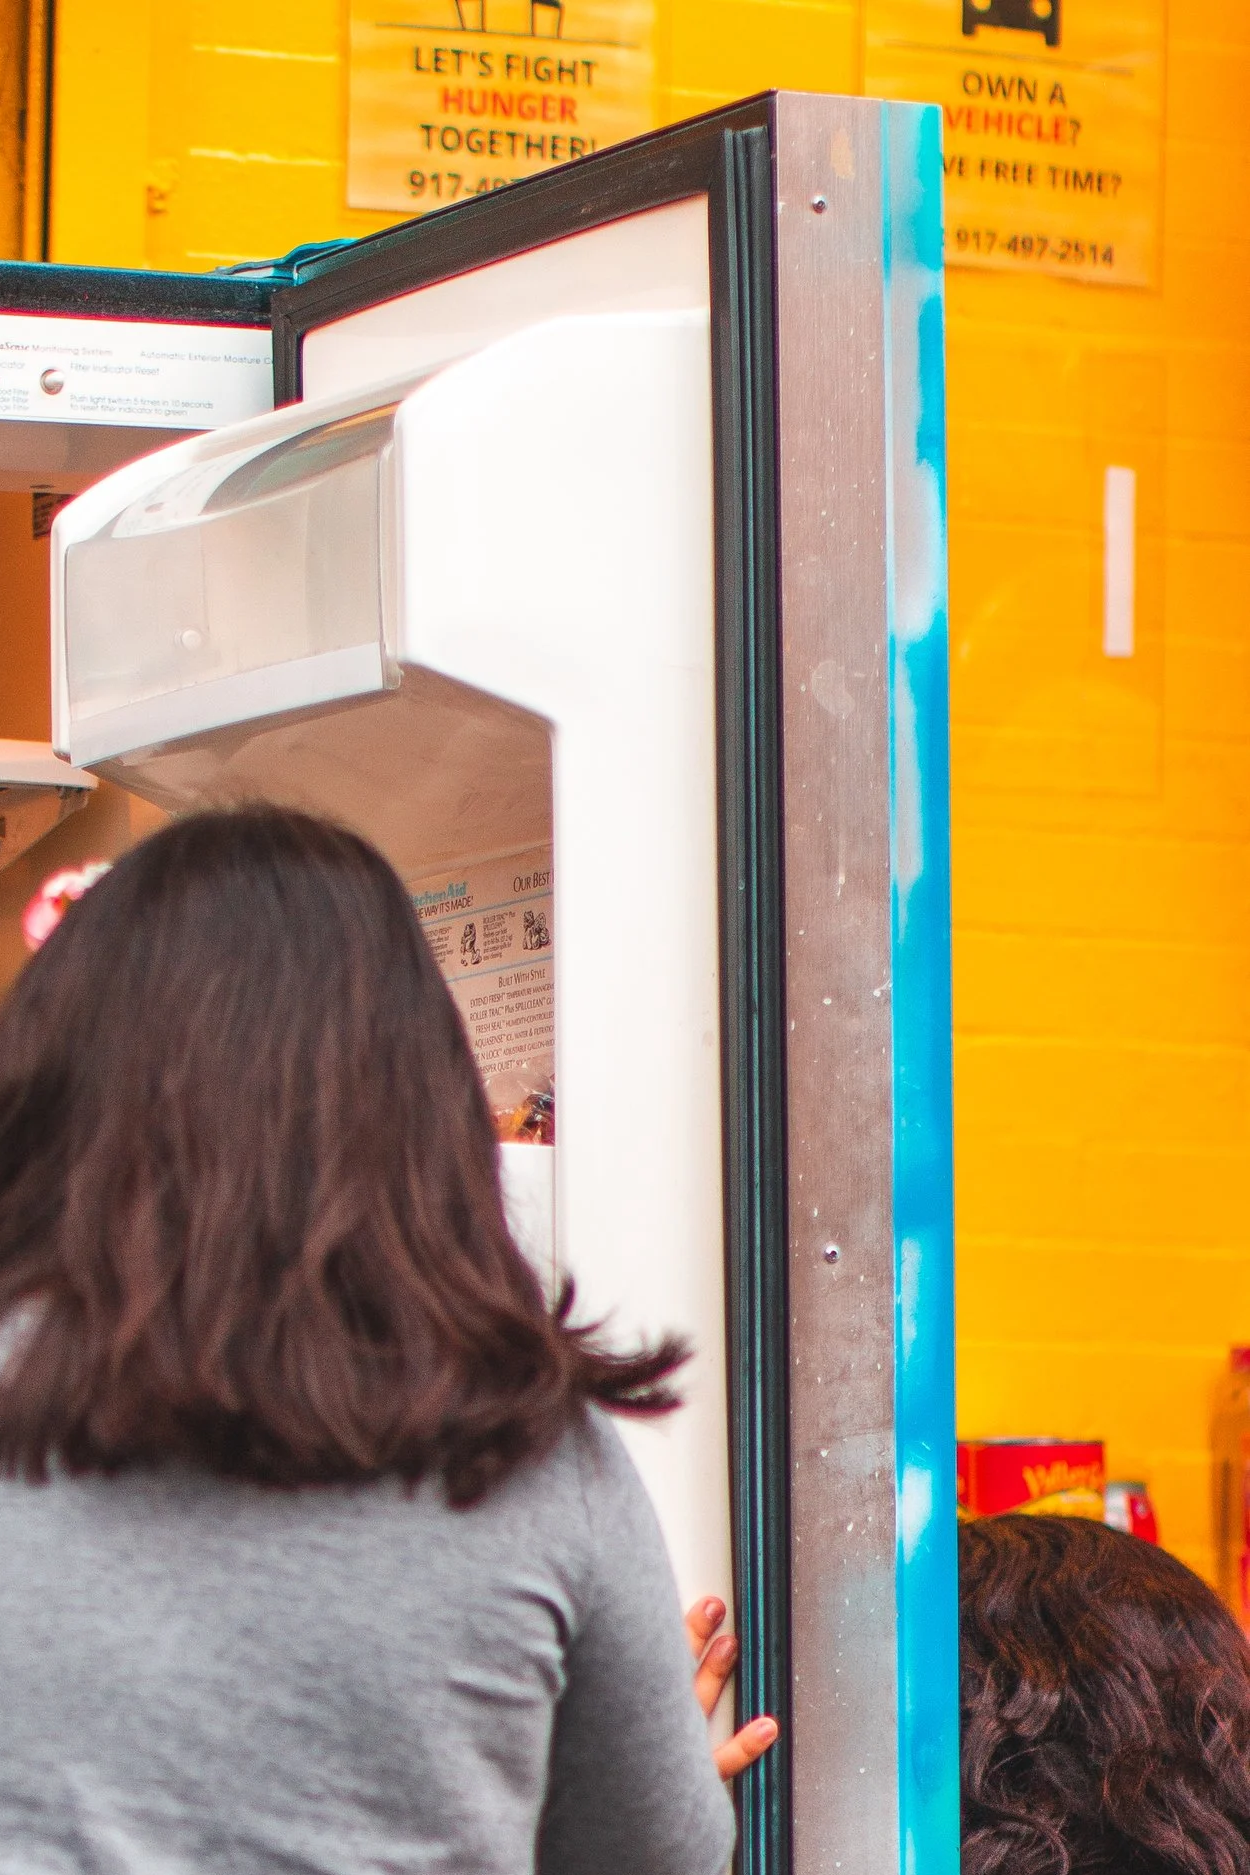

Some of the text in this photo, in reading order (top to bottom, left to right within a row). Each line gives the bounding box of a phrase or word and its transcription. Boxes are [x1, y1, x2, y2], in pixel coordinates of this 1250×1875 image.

[414, 46, 598, 86] LET'S FIGHT
[442, 88, 578, 124] HUNGER
[962, 69, 1067, 108] OWN A
[420, 124, 597, 161] TOGETHER!
[945, 105, 1081, 147] VEHICLE?
[980, 158, 1122, 197] FREE TIME?
[956, 228, 1115, 270] 917-497-2514
[70, 363, 160, 376] Filter Indicator Reset
[140, 350, 185, 361] Automatic
[188, 353, 221, 363] Exterior
[224, 355, 261, 365] Moisture
[182, 400, 213, 409] seconds
